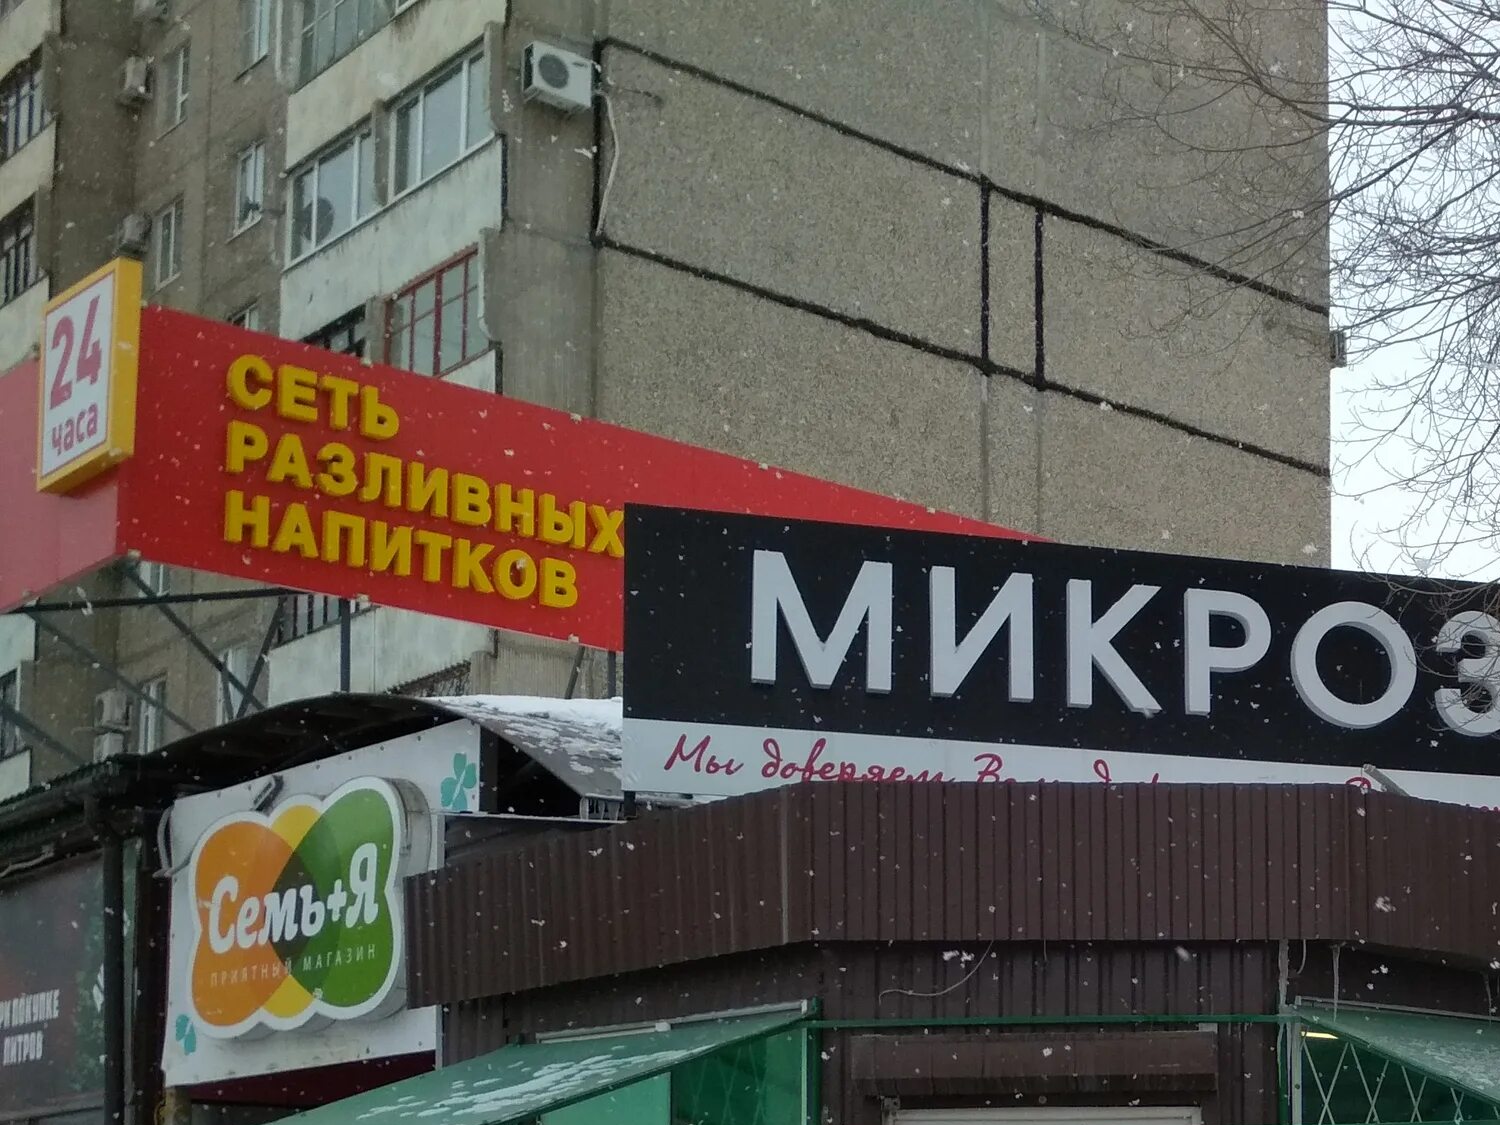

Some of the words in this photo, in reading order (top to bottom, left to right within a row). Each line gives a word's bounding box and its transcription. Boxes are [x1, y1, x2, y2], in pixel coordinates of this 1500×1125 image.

[50, 297, 103, 410] 24
[51, 402, 98, 456] часа
[226, 354, 400, 440] СЕТЬ
[226, 420, 625, 558] РАЗЛИВНЫХ
[224, 490, 578, 608] НАПИТКОВ
[664, 732, 744, 775] Мы
[211, 957, 292, 987] ПРИЯТНЫЙ
[303, 944, 376, 971] МАГАЗИН
